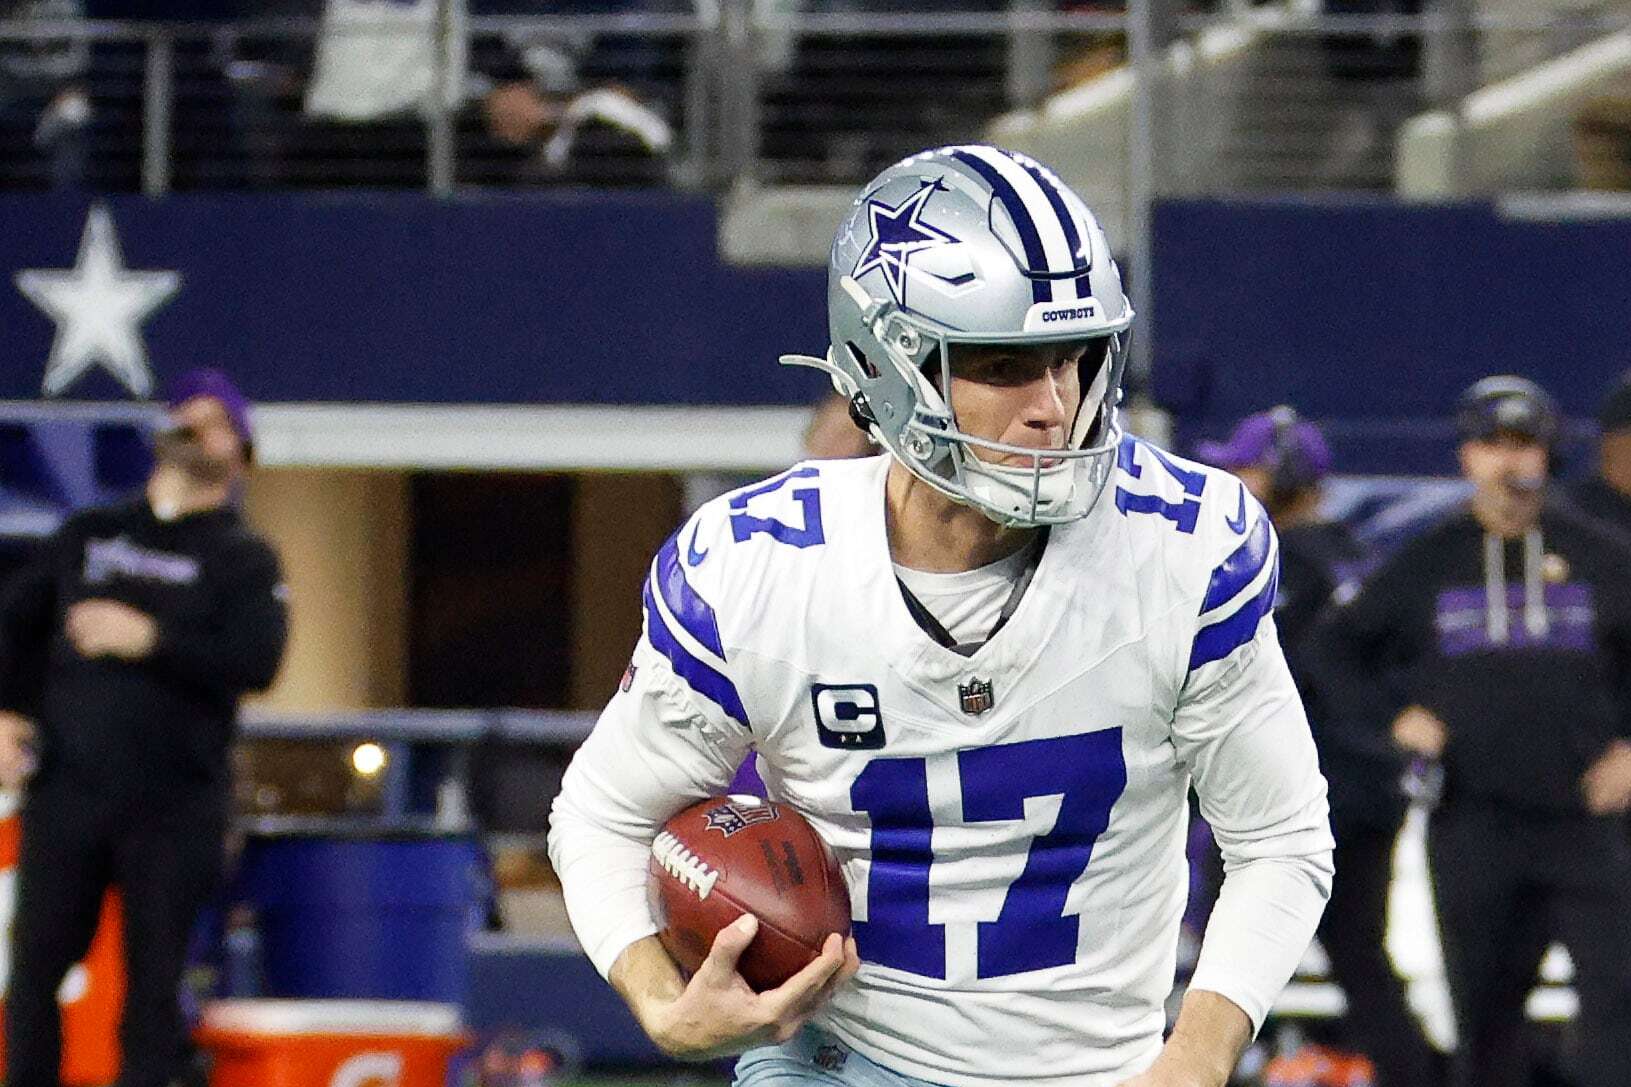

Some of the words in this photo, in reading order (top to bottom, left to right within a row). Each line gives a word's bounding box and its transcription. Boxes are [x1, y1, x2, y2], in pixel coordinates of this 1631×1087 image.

[1042, 306, 1095, 323] COWBOYS
[728, 466, 826, 549] 17
[1115, 431, 1207, 535] 17
[816, 688, 878, 733] C
[850, 725, 1128, 981] 17
